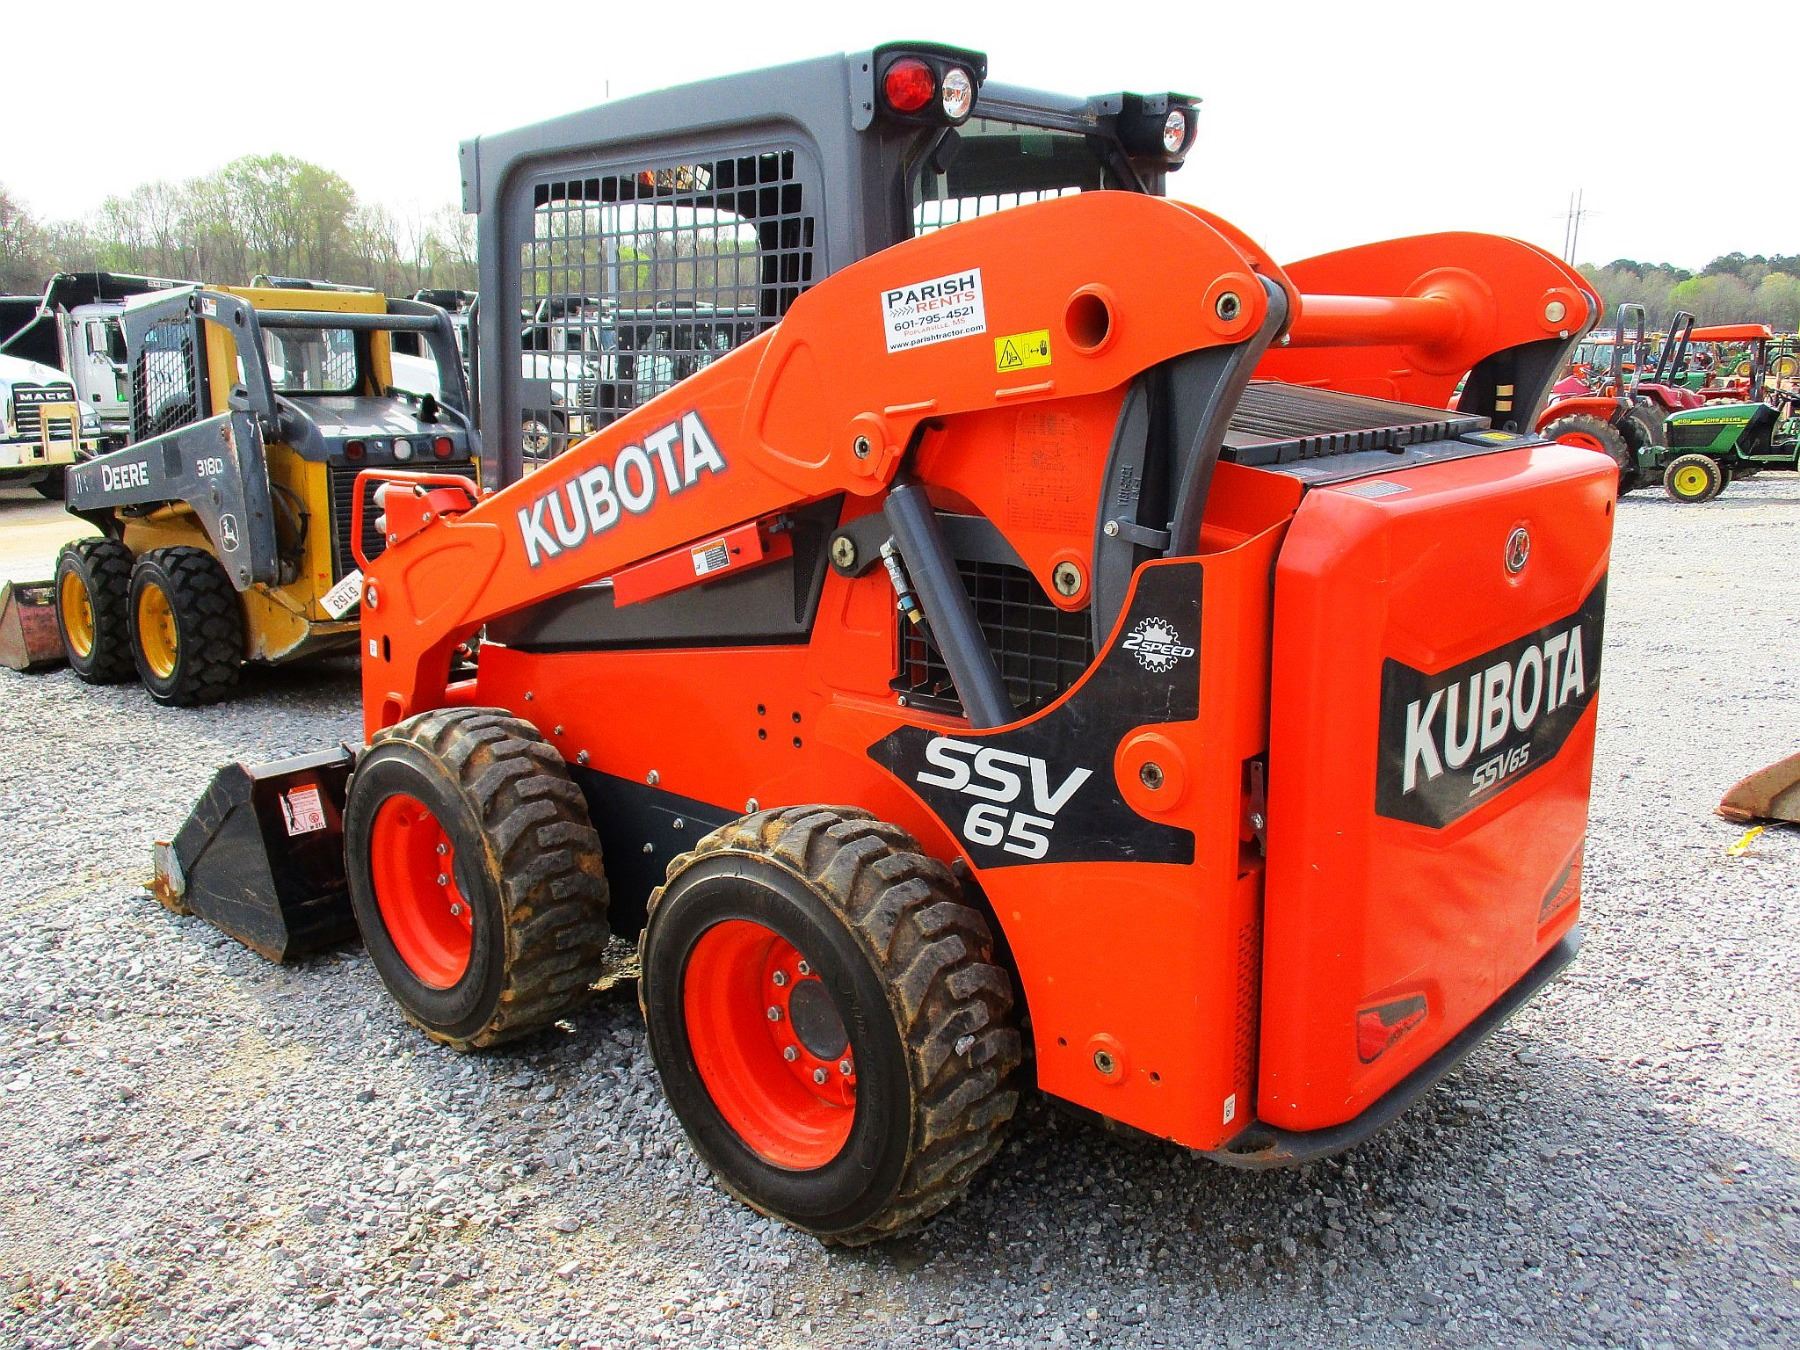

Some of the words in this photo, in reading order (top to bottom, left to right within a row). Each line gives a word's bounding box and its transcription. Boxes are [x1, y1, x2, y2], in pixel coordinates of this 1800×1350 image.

[887, 275, 975, 309] PARISH
[916, 291, 976, 314] RENTS
[894, 306, 975, 332] 601-795-4521
[952, 318, 967, 326] MS
[890, 323, 983, 350] www.parishtractor.com
[19, 392, 69, 401] MACK
[101, 461, 150, 492] DEERE
[196, 457, 223, 477] 318D
[517, 410, 726, 567] KUBOTA
[1122, 632, 1144, 650] 2
[1139, 641, 1195, 658] SPEED
[1402, 624, 1585, 796] KUBOTA
[916, 736, 1094, 816] SSV
[1468, 742, 1531, 797] SSV65
[963, 802, 1055, 860] 65
